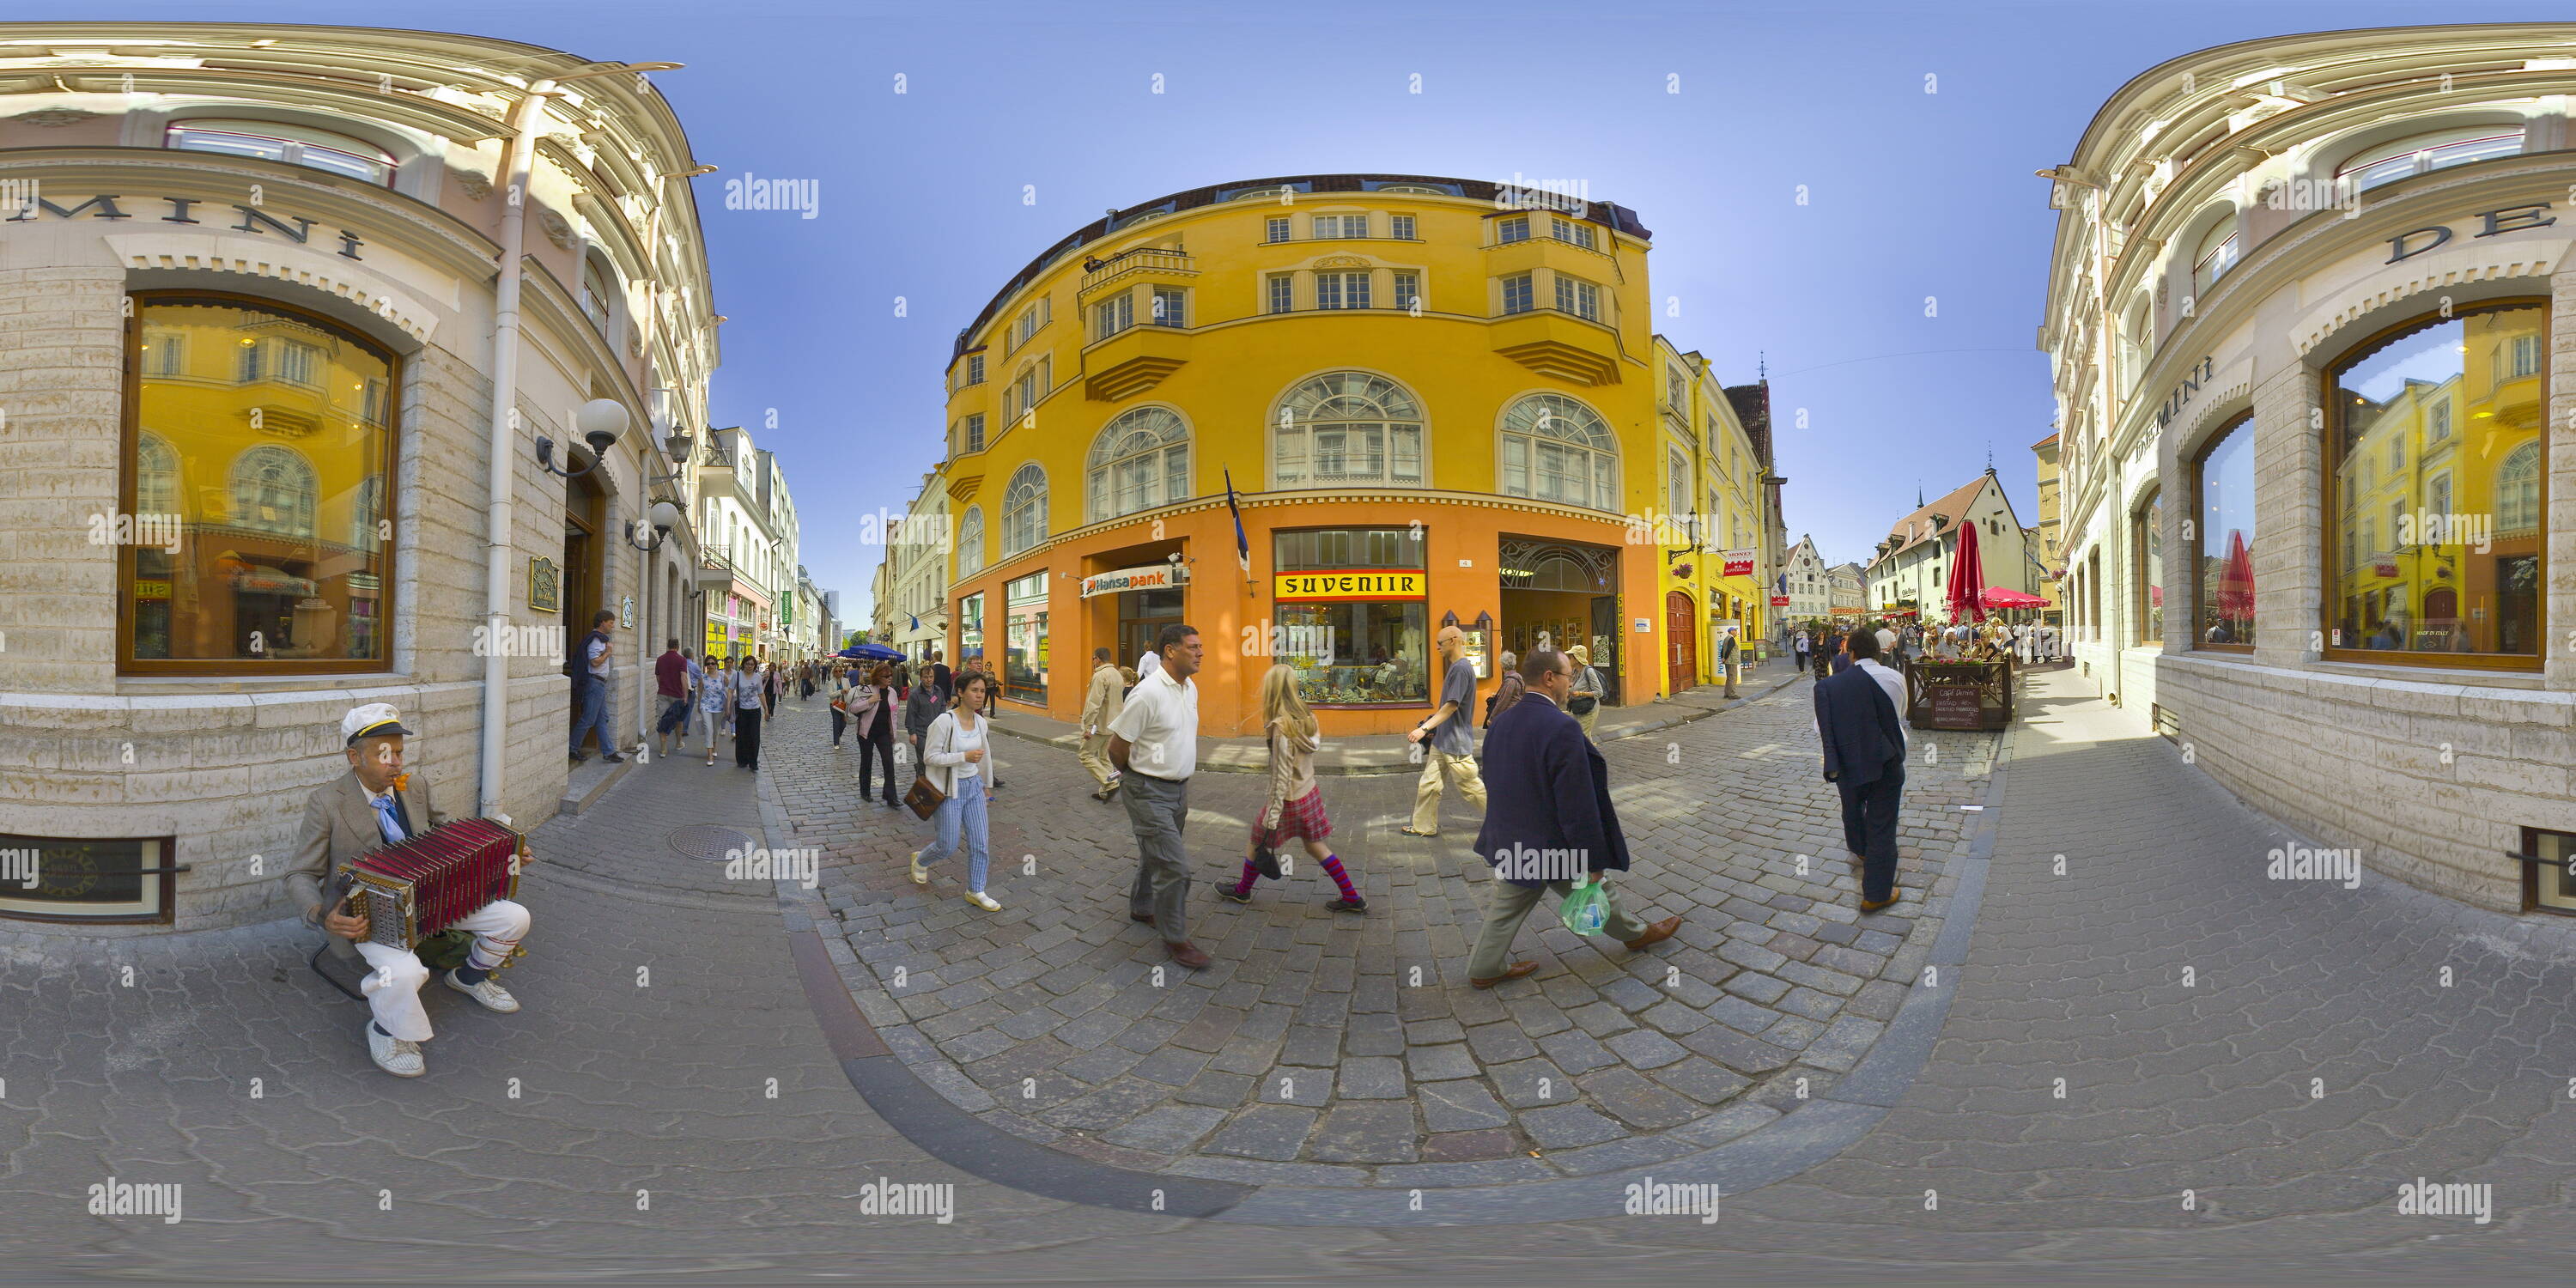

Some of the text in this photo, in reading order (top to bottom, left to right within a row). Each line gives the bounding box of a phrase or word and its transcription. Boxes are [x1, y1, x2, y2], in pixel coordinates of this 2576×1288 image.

[2385, 202, 2557, 265] DE
[1096, 571, 1165, 592] Hansapank
[1285, 576, 1415, 593] SUVENIIR
